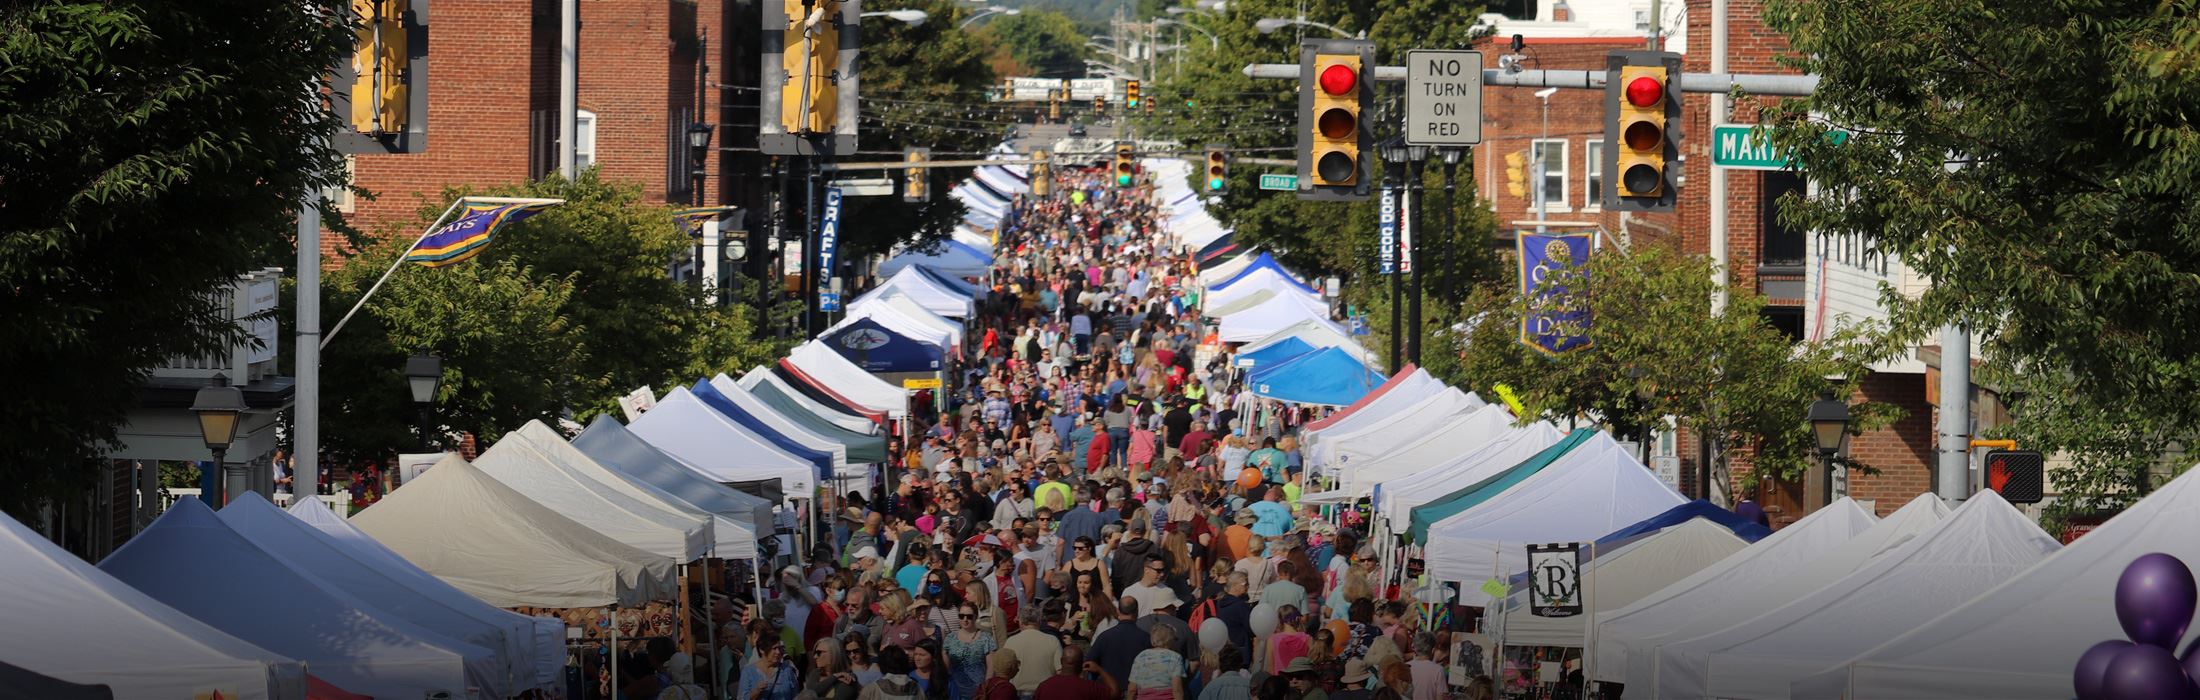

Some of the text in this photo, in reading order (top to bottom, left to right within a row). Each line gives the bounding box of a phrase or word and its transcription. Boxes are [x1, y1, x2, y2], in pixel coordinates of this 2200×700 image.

[1429, 60, 1460, 76] NO
[1424, 83, 1466, 96] TURN
[1434, 103, 1455, 116] ON
[1428, 123, 1460, 136] RED
[1264, 177, 1290, 187] BROAD
[820, 191, 839, 282] CRAFTS
[1381, 189, 1395, 271] FOOD COURT
[1543, 566, 1569, 597] R
